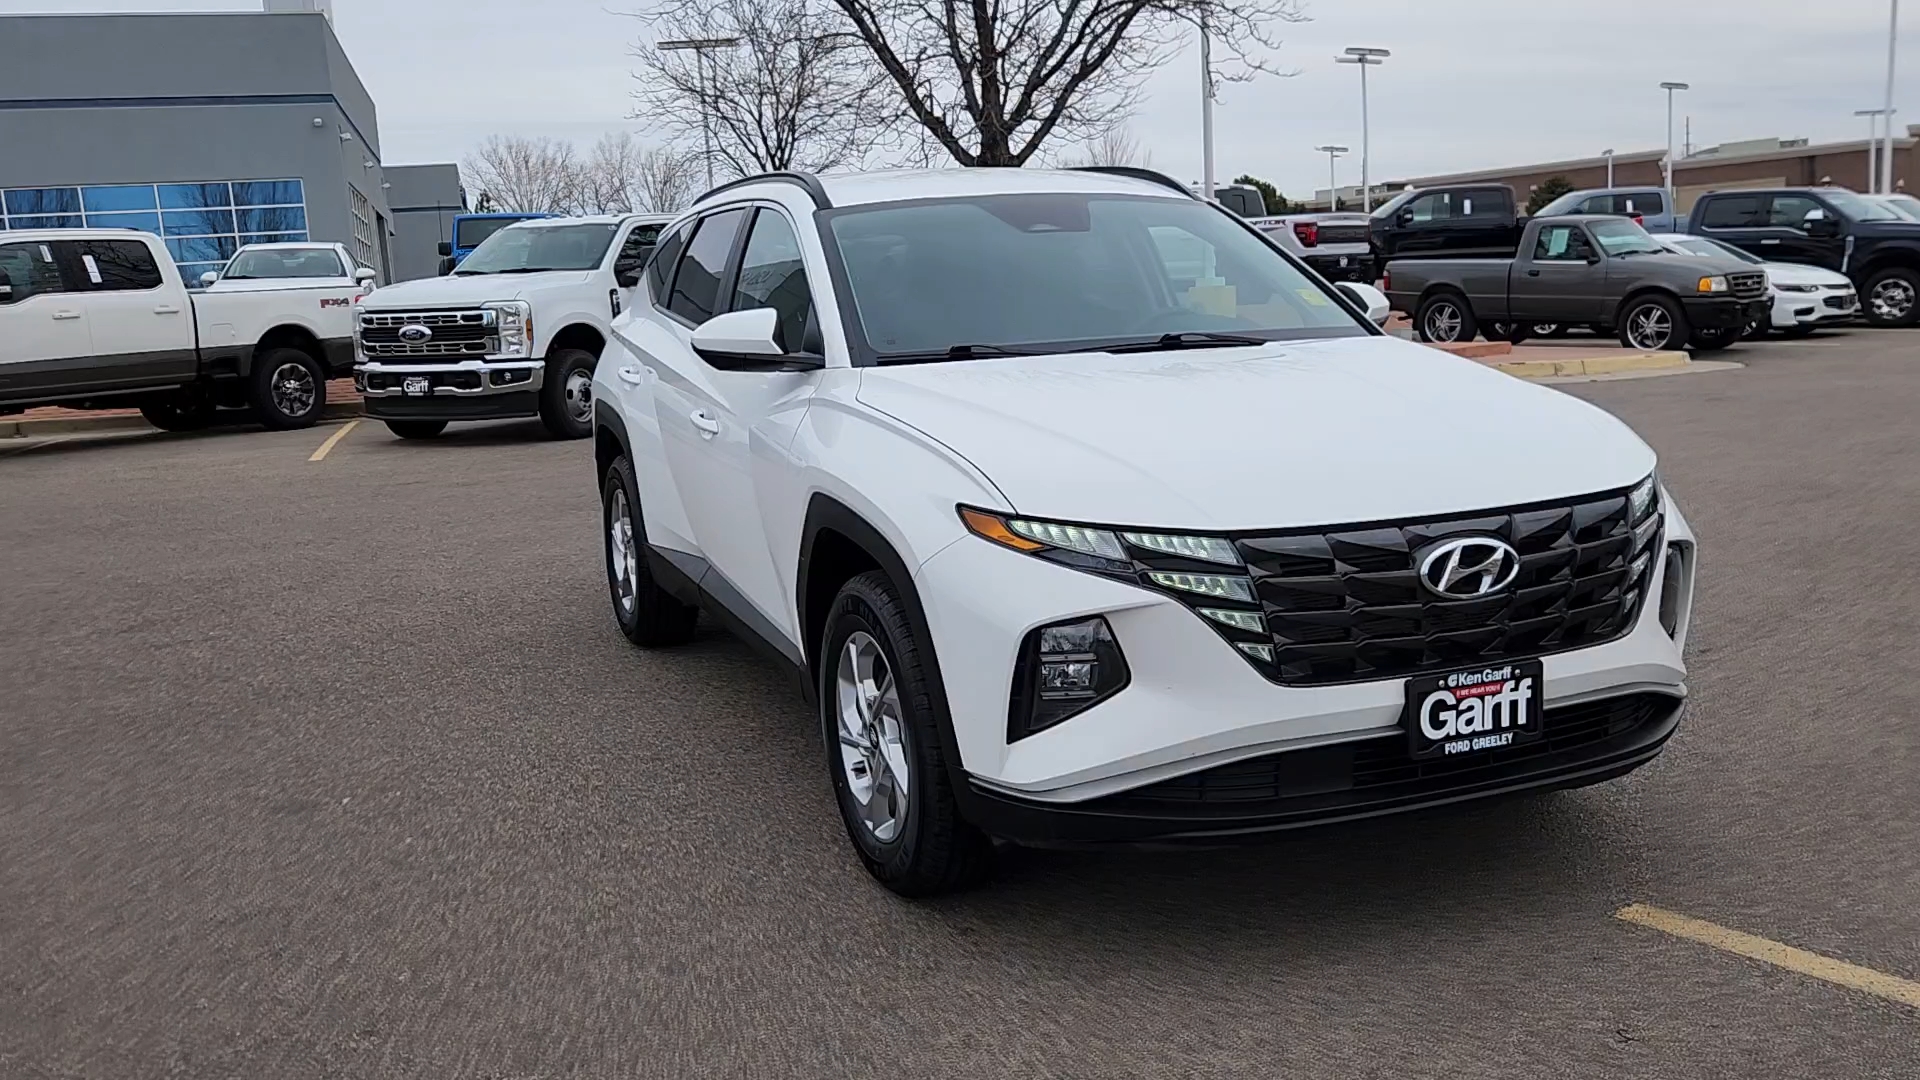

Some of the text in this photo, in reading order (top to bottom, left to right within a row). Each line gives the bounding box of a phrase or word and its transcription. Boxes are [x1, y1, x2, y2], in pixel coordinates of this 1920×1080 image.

[404, 380, 429, 392] Garff
[1458, 672, 1482, 686] Ken
[1482, 665, 1512, 682] Garff
[1420, 677, 1532, 740] Garff
[1444, 732, 1514, 755] FORD GREELEY
